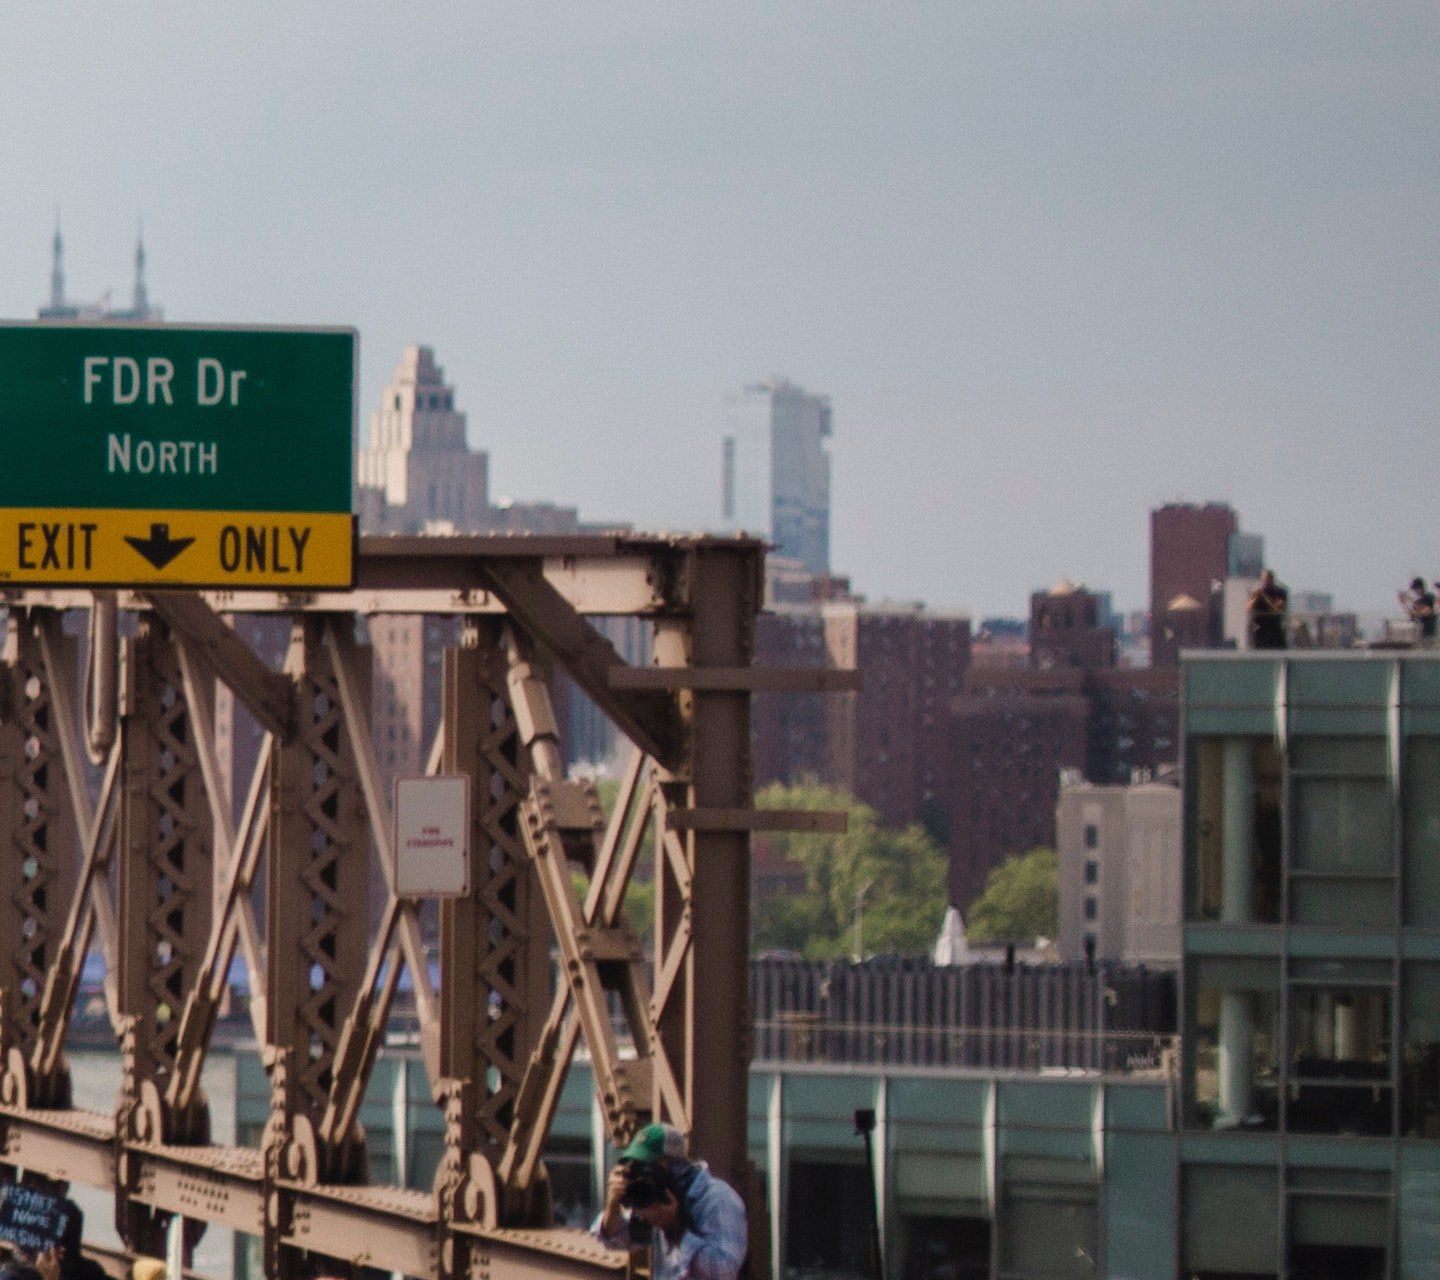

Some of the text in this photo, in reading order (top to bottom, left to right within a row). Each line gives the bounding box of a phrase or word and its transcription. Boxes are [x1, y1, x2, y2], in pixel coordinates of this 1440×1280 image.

[84, 356, 247, 406] FDR Dr
[108, 434, 218, 475] NORTH
[18, 523, 311, 573] EXIT ONLY
